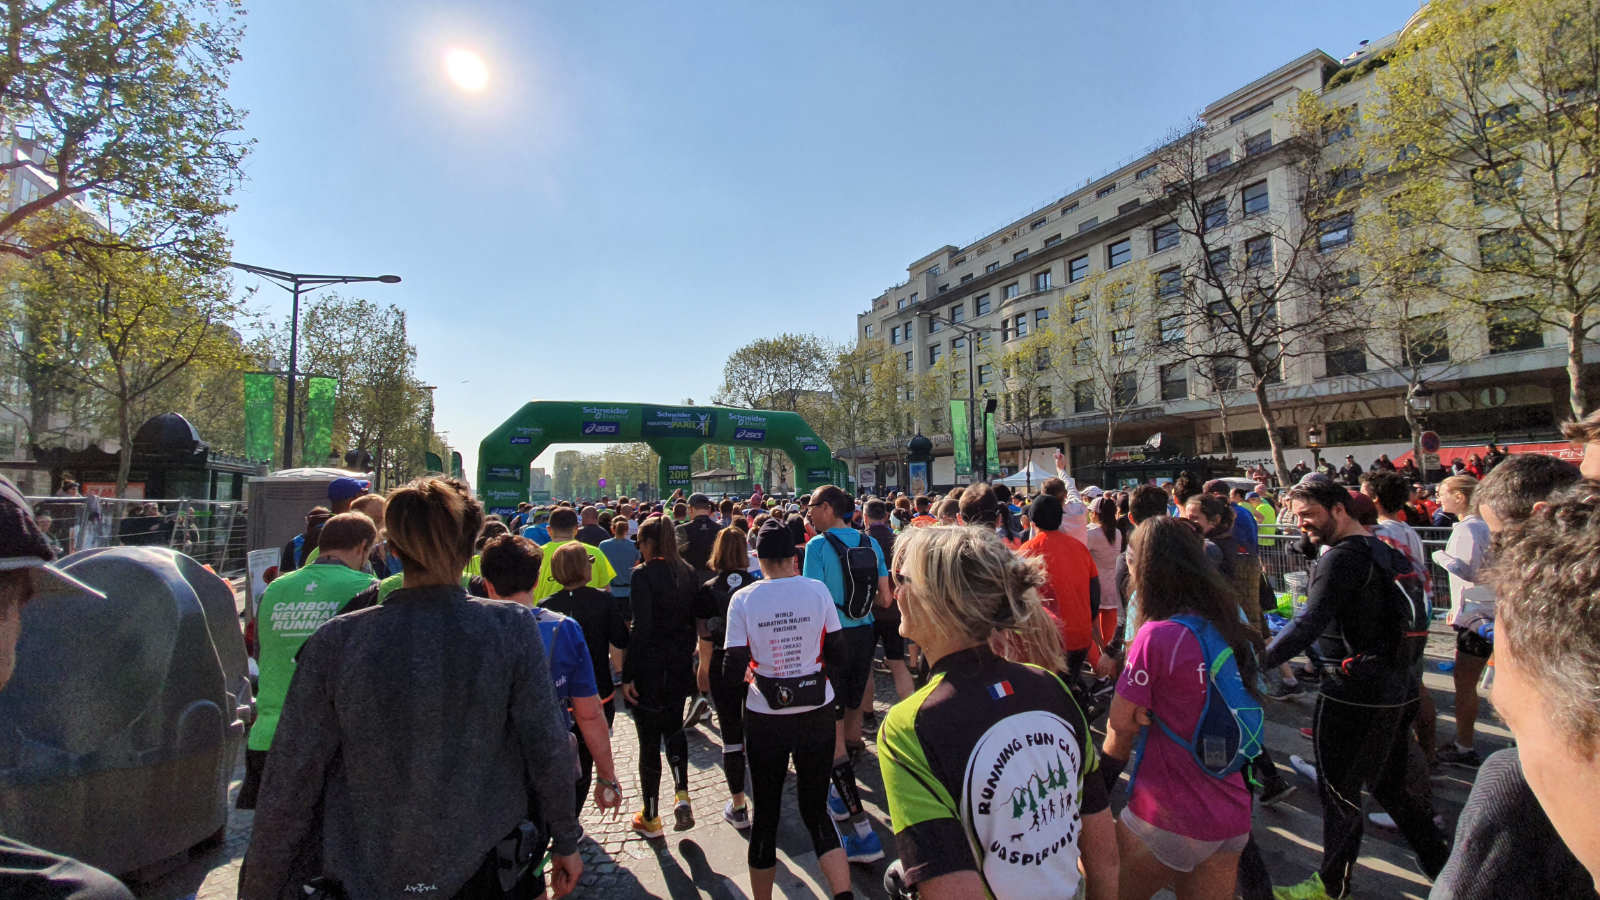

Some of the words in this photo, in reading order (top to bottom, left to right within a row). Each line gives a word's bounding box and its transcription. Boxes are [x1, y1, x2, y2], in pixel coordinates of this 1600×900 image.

[583, 406, 629, 416] Schneider
[728, 412, 767, 423] Schneider
[273, 601, 340, 611] CARBON
[758, 618, 788, 628] MARATHON
[978, 738, 1023, 815] RUNNING
[1025, 732, 1054, 747] FUN
